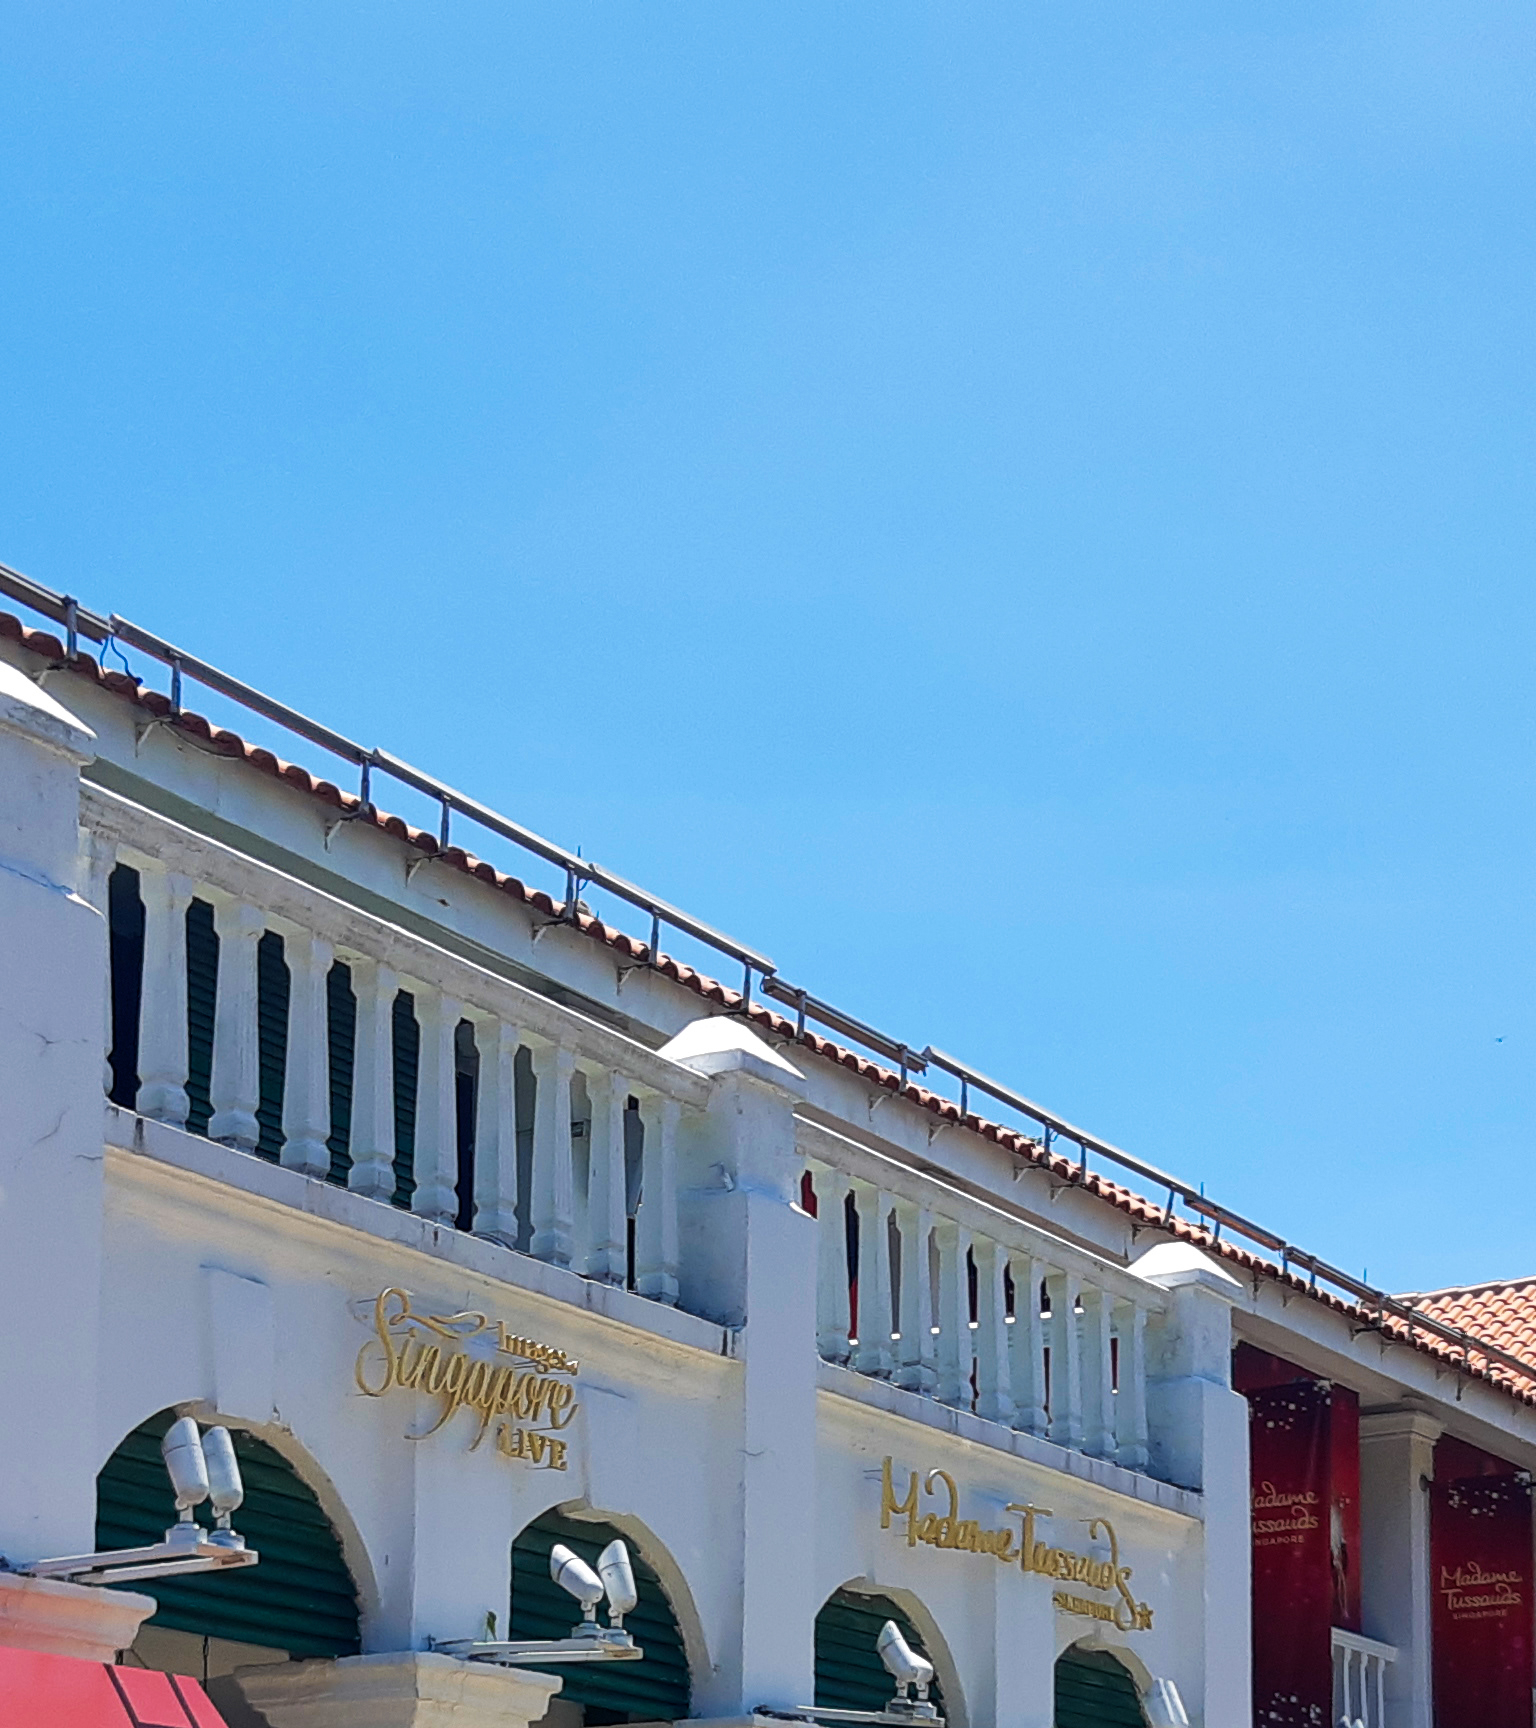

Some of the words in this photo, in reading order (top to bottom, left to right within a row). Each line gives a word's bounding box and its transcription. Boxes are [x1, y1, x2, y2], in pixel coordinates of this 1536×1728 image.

[355, 1287, 579, 1451] Singapore
[497, 1423, 569, 1471] LIVE
[1251, 1481, 1319, 1508] adame
[880, 1455, 1020, 1563] Madame
[1005, 1502, 1141, 1631] Tussauds
[1440, 1560, 1523, 1588] Madame
[1440, 1583, 1523, 1610] Tussauds
